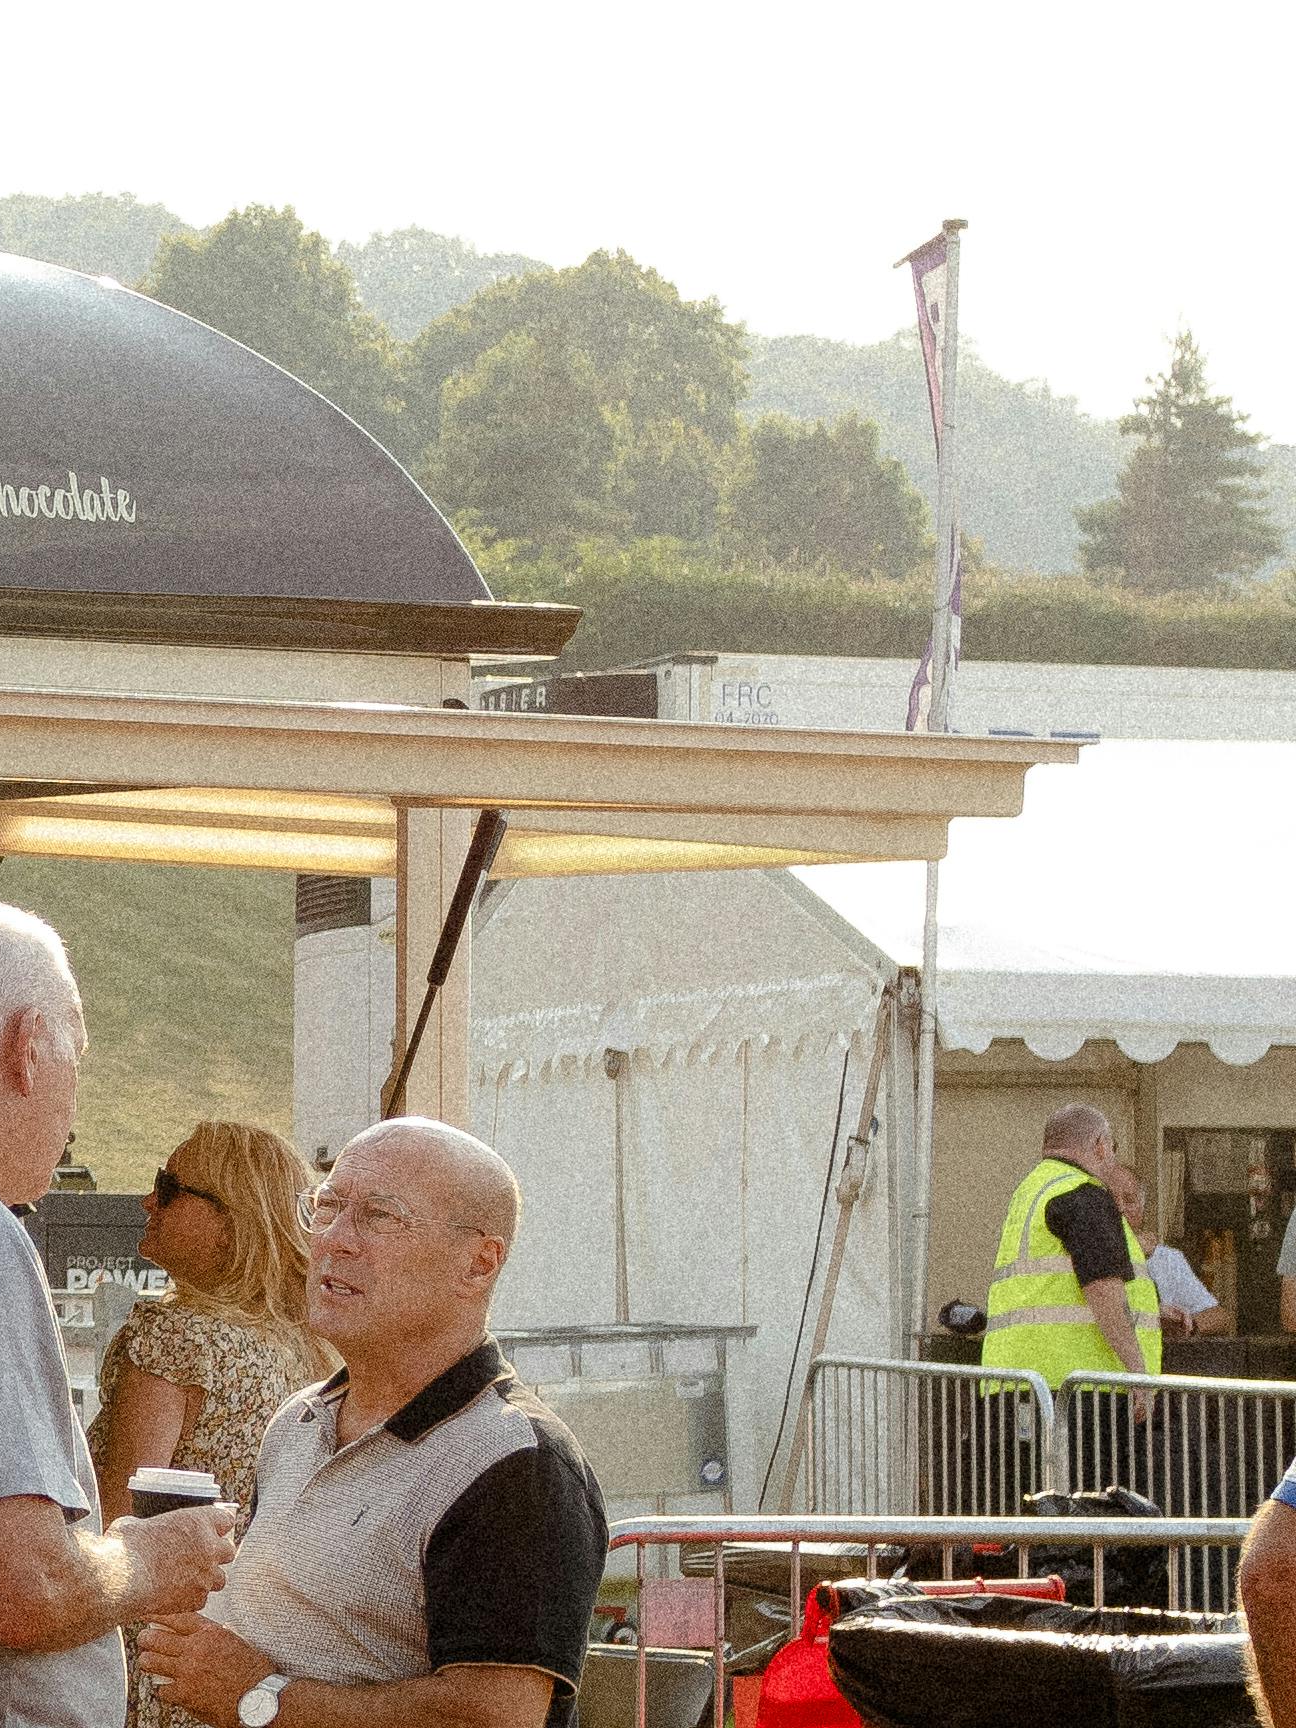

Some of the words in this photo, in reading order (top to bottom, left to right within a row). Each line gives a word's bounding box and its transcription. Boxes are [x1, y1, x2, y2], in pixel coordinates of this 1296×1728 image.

[721, 682, 772, 708] FRC
[66, 1255, 135, 1270] PROJECT
[66, 1268, 169, 1294] POWE
